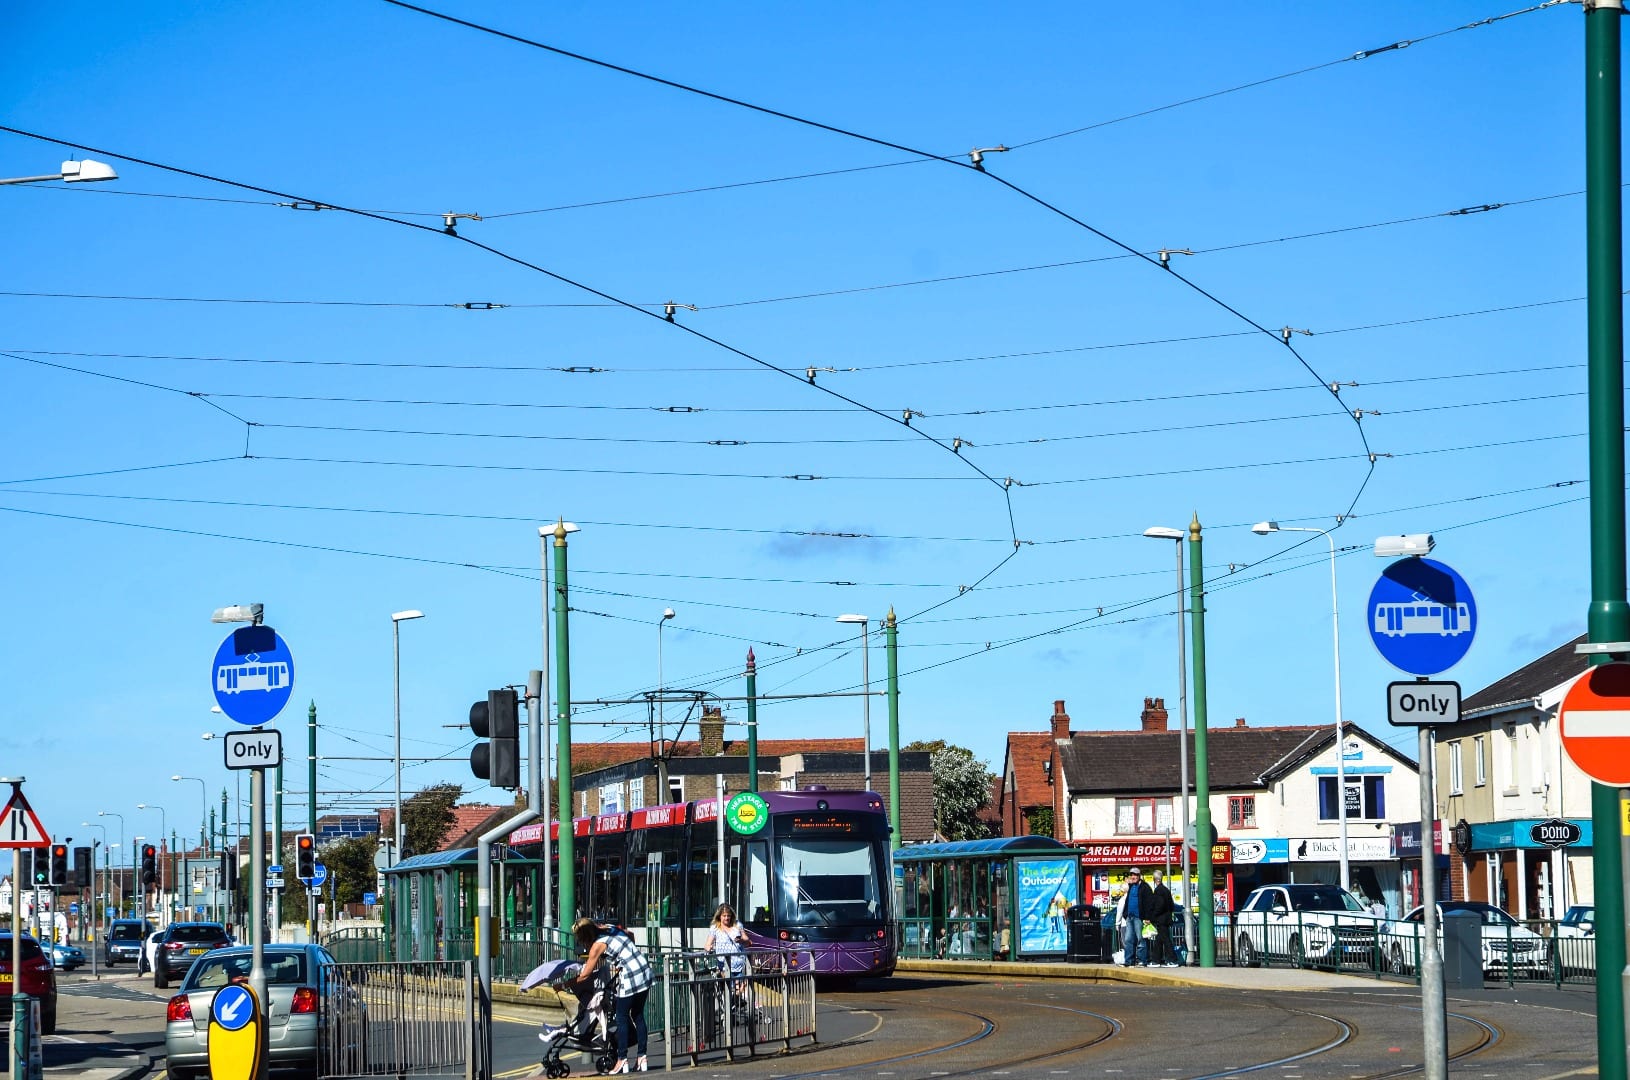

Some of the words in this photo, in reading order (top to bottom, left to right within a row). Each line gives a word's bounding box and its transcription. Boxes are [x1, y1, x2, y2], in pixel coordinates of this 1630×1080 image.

[1400, 693, 1450, 716] Only
[233, 740, 272, 759] Only
[730, 795, 763, 810] HERITAGE
[731, 816, 748, 832] TRAM
[749, 814, 763, 831] STOP
[1541, 826, 1570, 839] BOHO
[1136, 846, 1175, 856] BOOZE
[1312, 842, 1338, 852] Black
[1022, 868, 1038, 876] The
[1022, 876, 1067, 886] Outdoors
